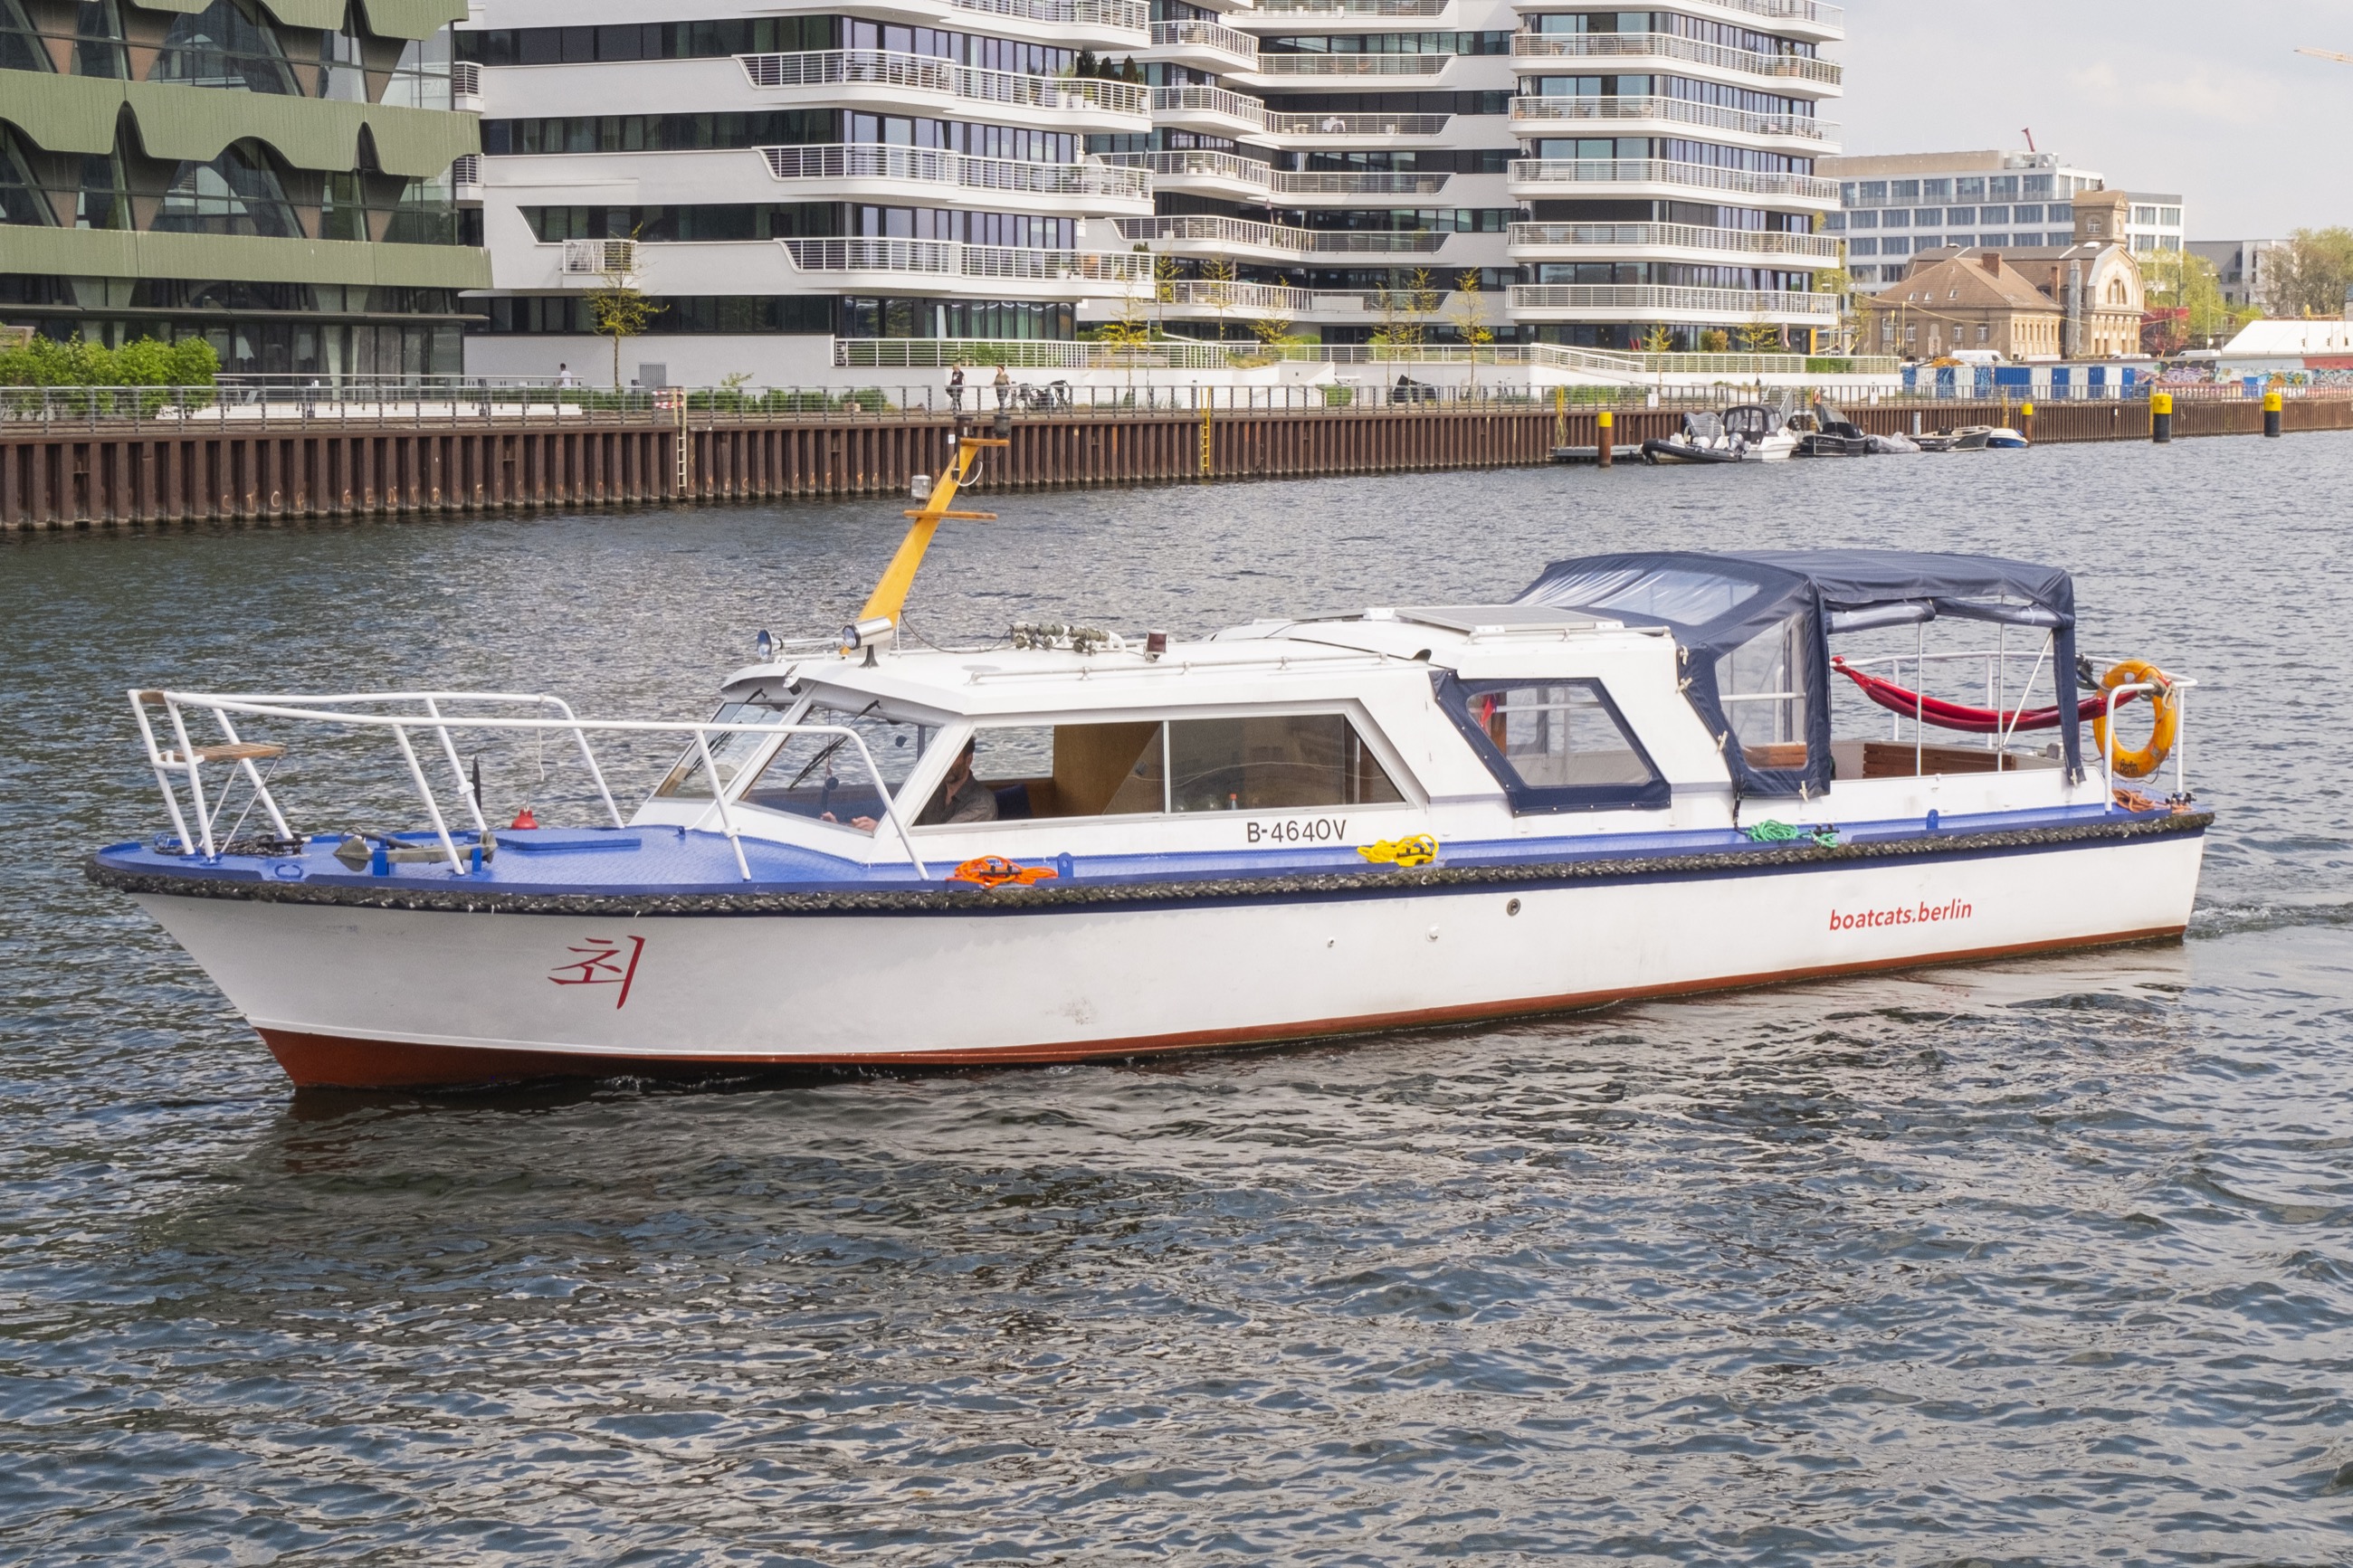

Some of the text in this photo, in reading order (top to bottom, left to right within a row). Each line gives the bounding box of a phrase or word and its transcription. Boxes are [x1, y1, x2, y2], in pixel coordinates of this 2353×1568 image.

[2120, 758, 2139, 775] Berlin
[1829, 898, 1972, 931] boatcats.berlin
[548, 935, 645, 1010] 최
